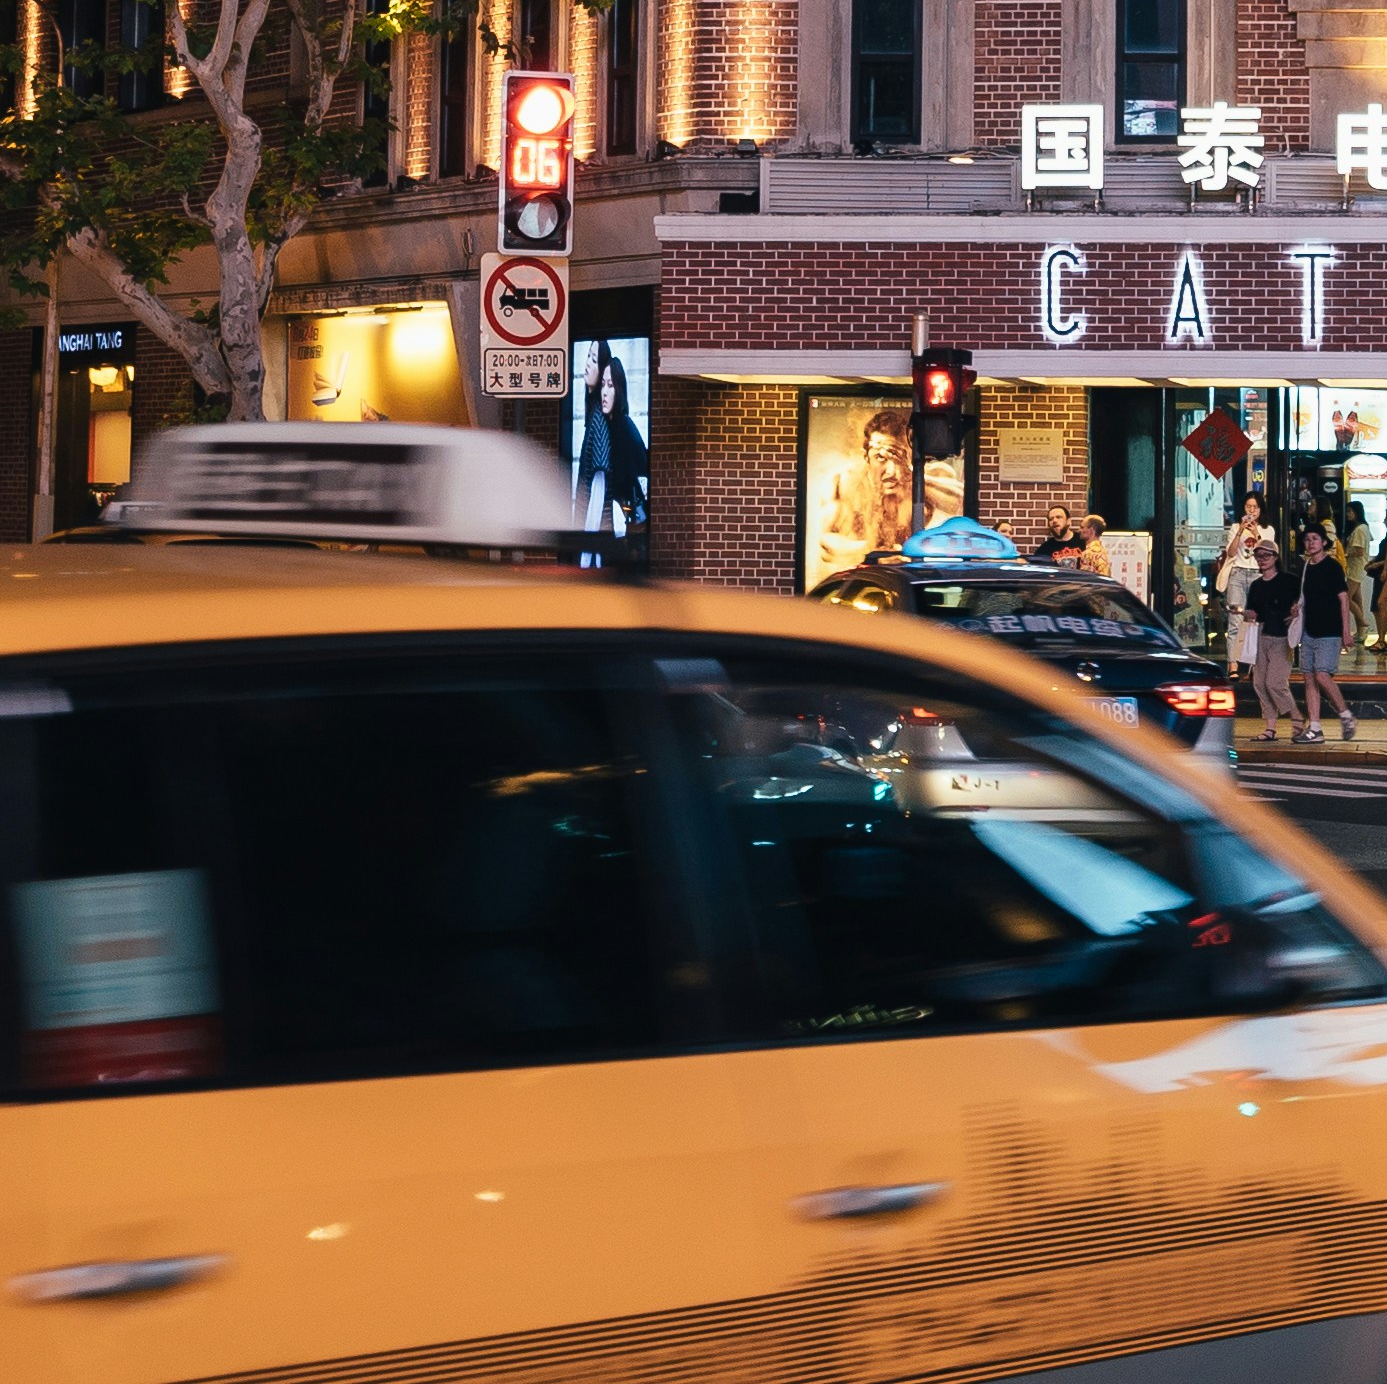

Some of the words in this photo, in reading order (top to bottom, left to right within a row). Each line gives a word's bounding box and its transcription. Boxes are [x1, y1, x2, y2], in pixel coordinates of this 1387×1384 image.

[513, 138, 560, 185] 06
[95, 331, 122, 349] TANG
[490, 372, 561, 388] 大型号牌
